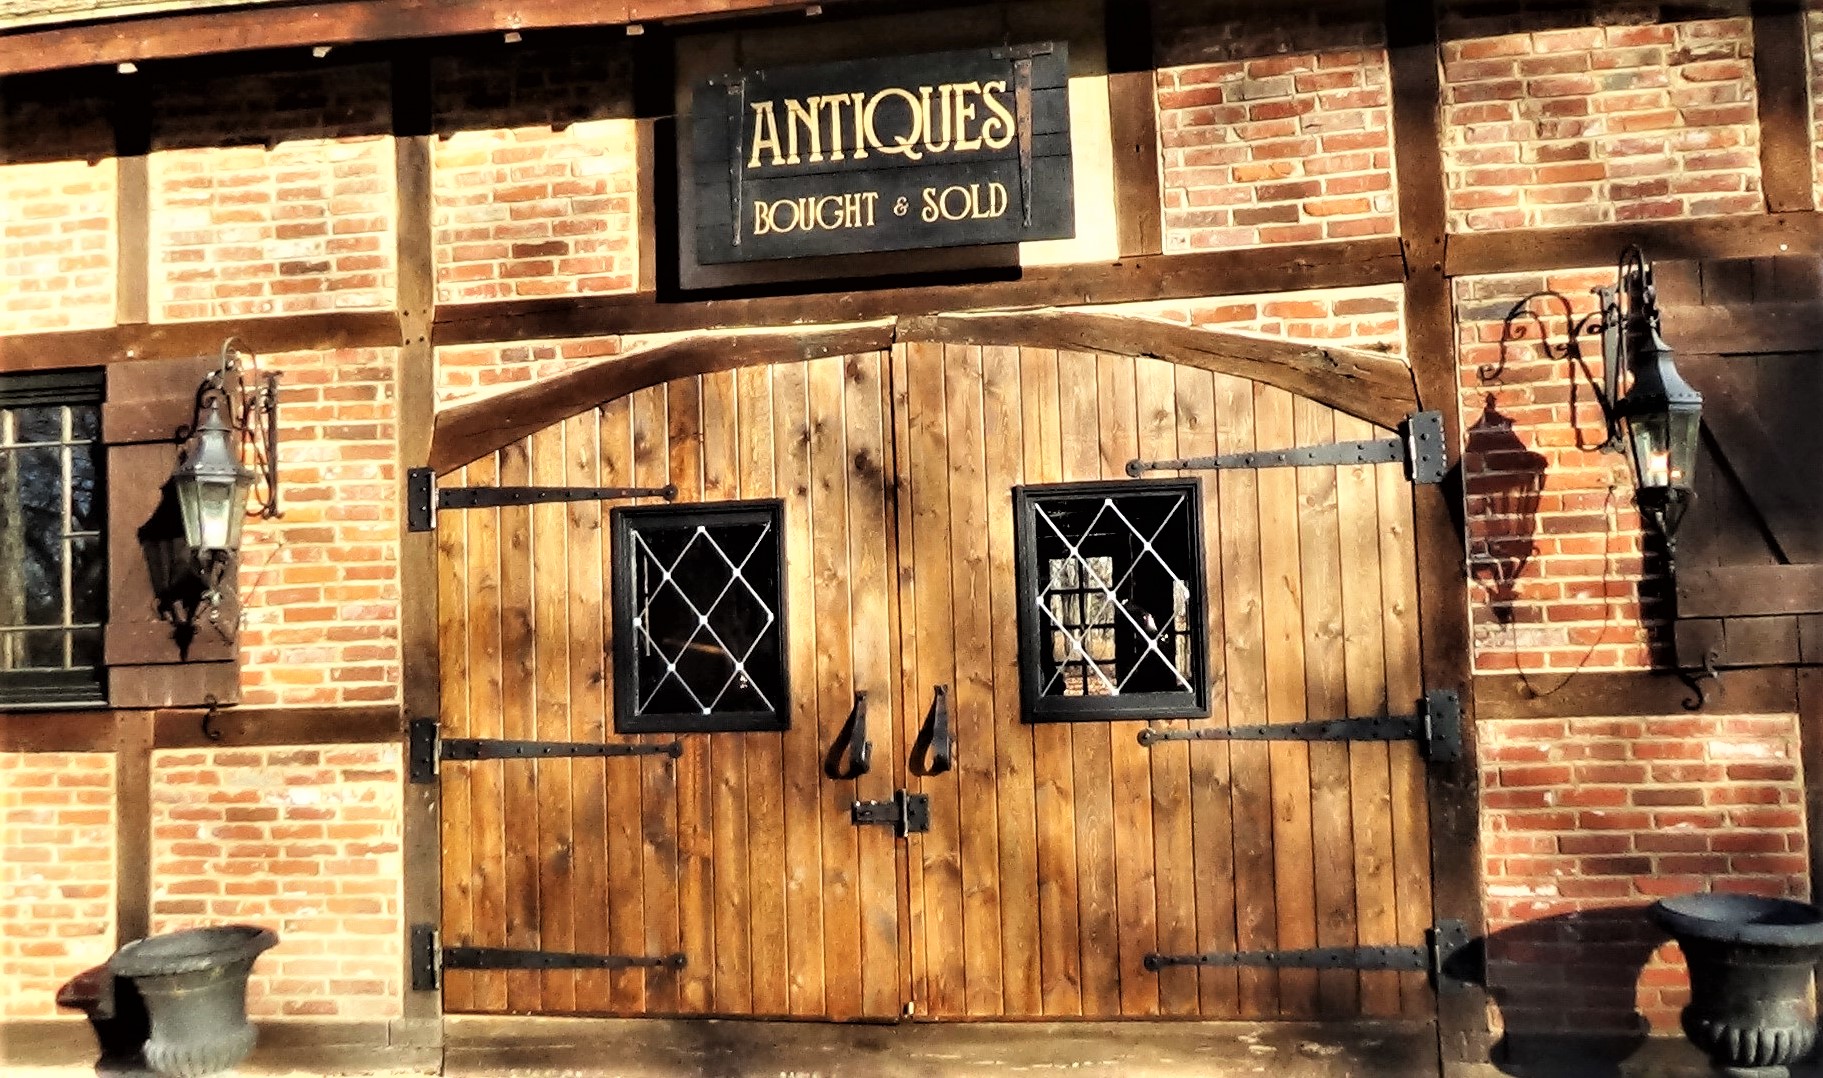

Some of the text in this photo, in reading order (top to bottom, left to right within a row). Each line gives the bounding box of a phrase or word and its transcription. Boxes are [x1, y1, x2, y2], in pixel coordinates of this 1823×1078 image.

[748, 80, 1015, 168] ANTIQUES
[753, 182, 1009, 235] BOUGHT & SOLD
